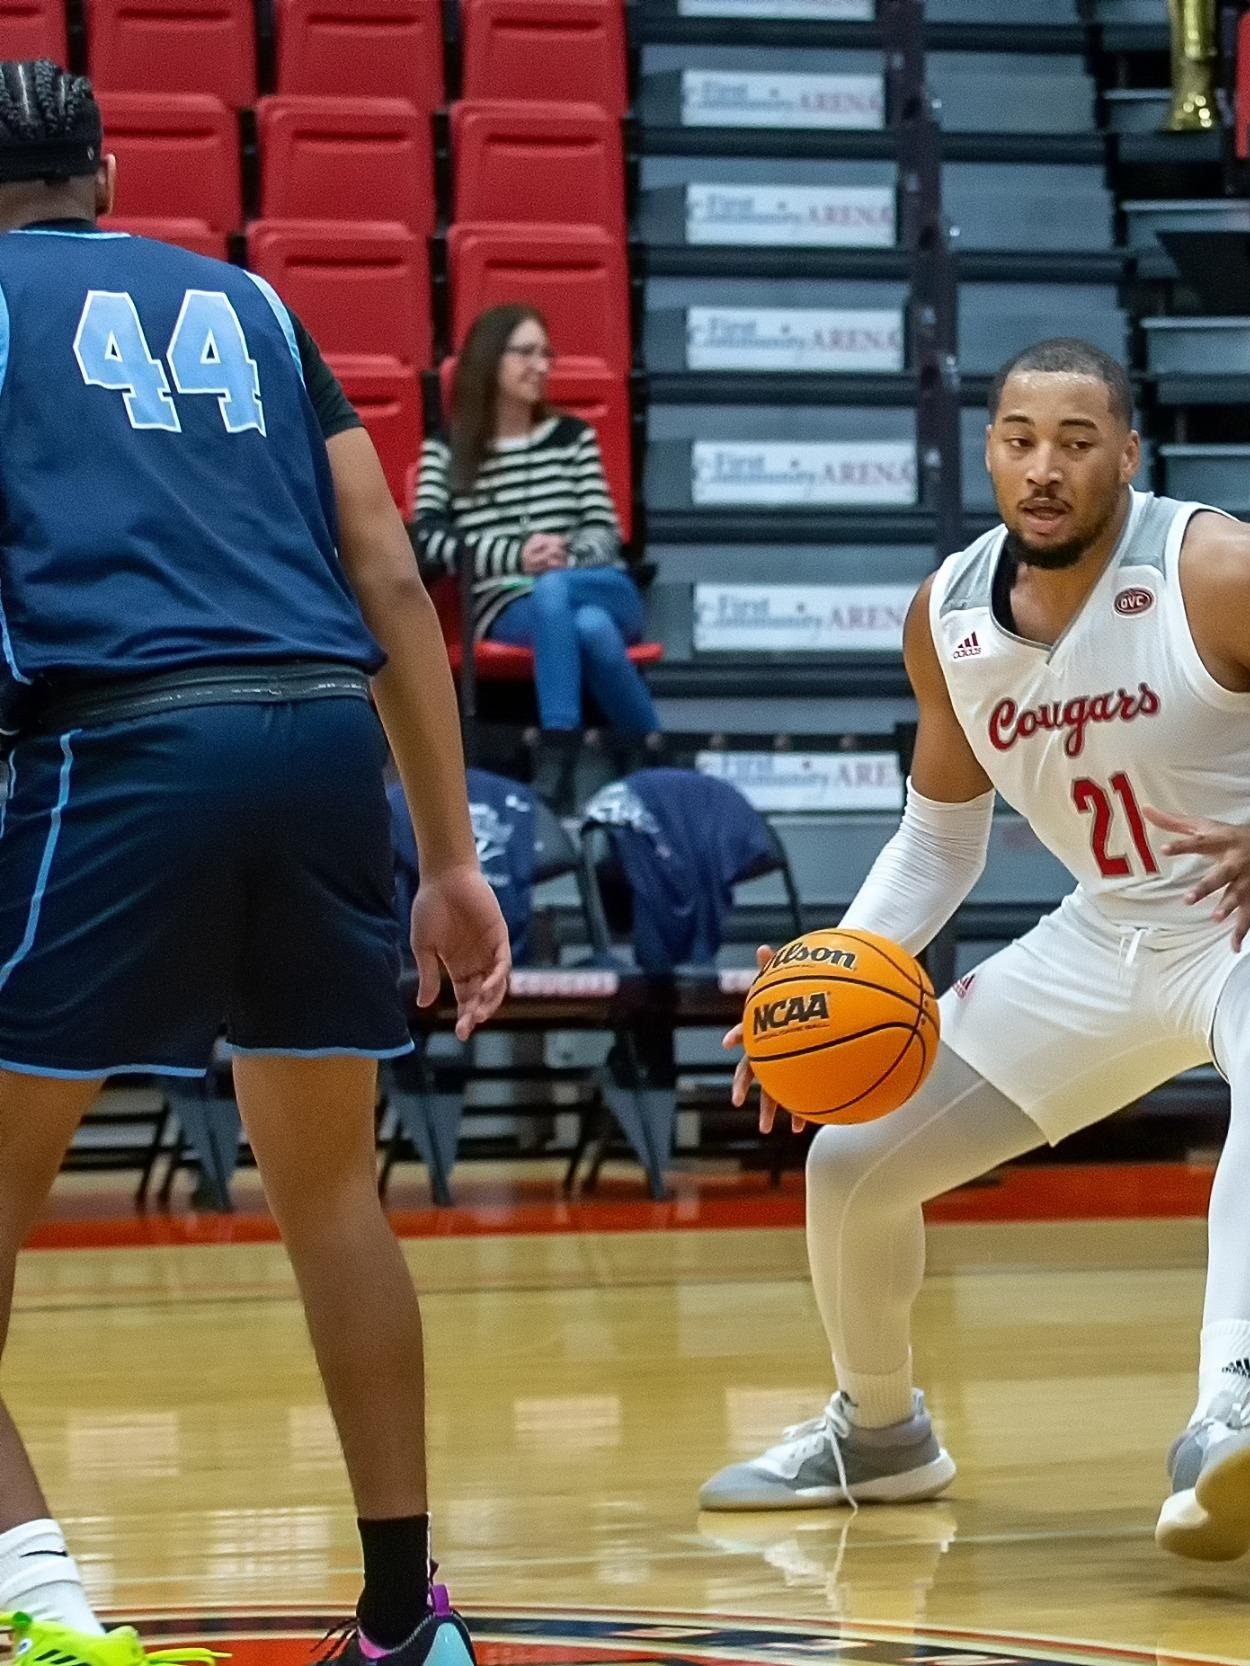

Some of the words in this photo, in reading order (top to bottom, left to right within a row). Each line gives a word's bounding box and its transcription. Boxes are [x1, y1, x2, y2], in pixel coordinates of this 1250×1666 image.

[72, 289, 267, 438] 44
[830, 605, 904, 630] AREN
[989, 682, 1160, 759] Cougars
[1071, 771, 1159, 879] 21
[757, 943, 857, 981] ilson
[753, 992, 830, 1035] NCAA
